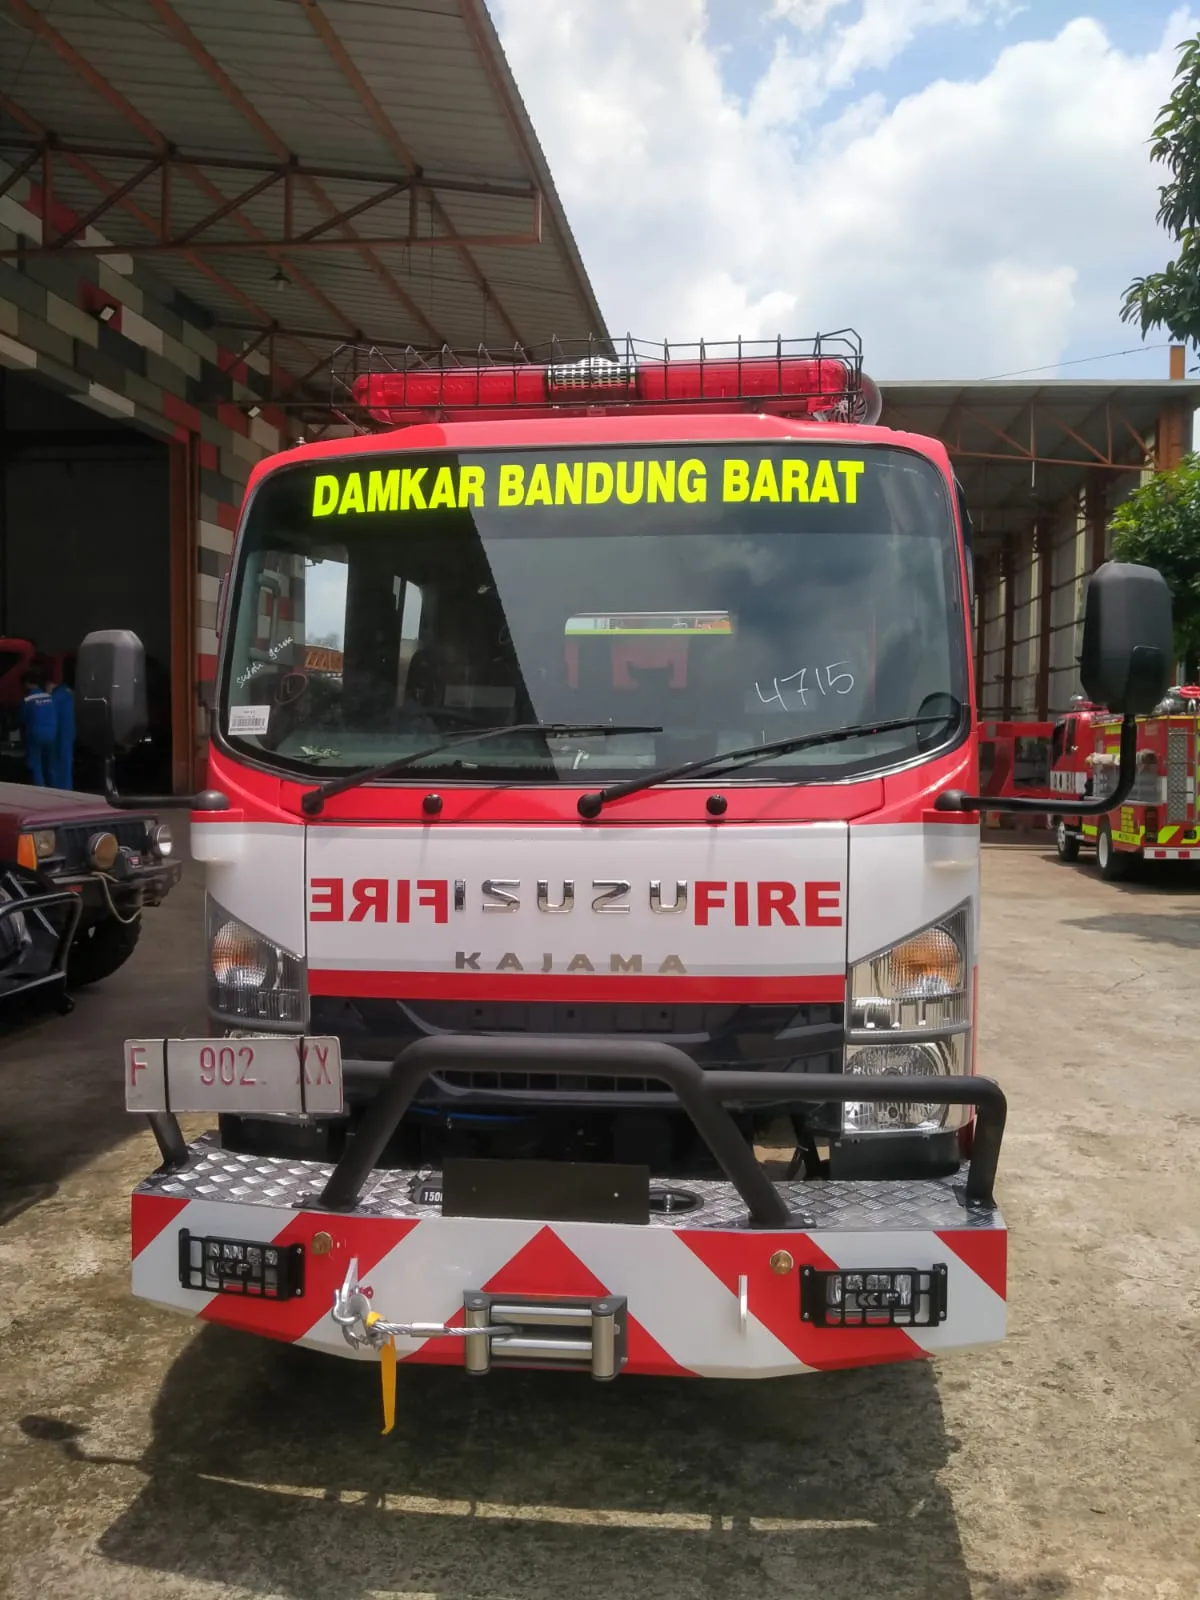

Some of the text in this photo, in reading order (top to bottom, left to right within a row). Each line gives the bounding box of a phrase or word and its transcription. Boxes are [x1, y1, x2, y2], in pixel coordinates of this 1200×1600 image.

[312, 459, 864, 517] DAMKAR BANDUNG BARAT
[755, 660, 854, 712] 4715
[454, 879, 688, 915] ISUZU
[694, 880, 843, 927] FIRE
[455, 951, 688, 974] KAJAMA
[130, 1046, 149, 1087] F
[200, 1046, 256, 1087] 902
[424, 1191, 443, 1202] 150
